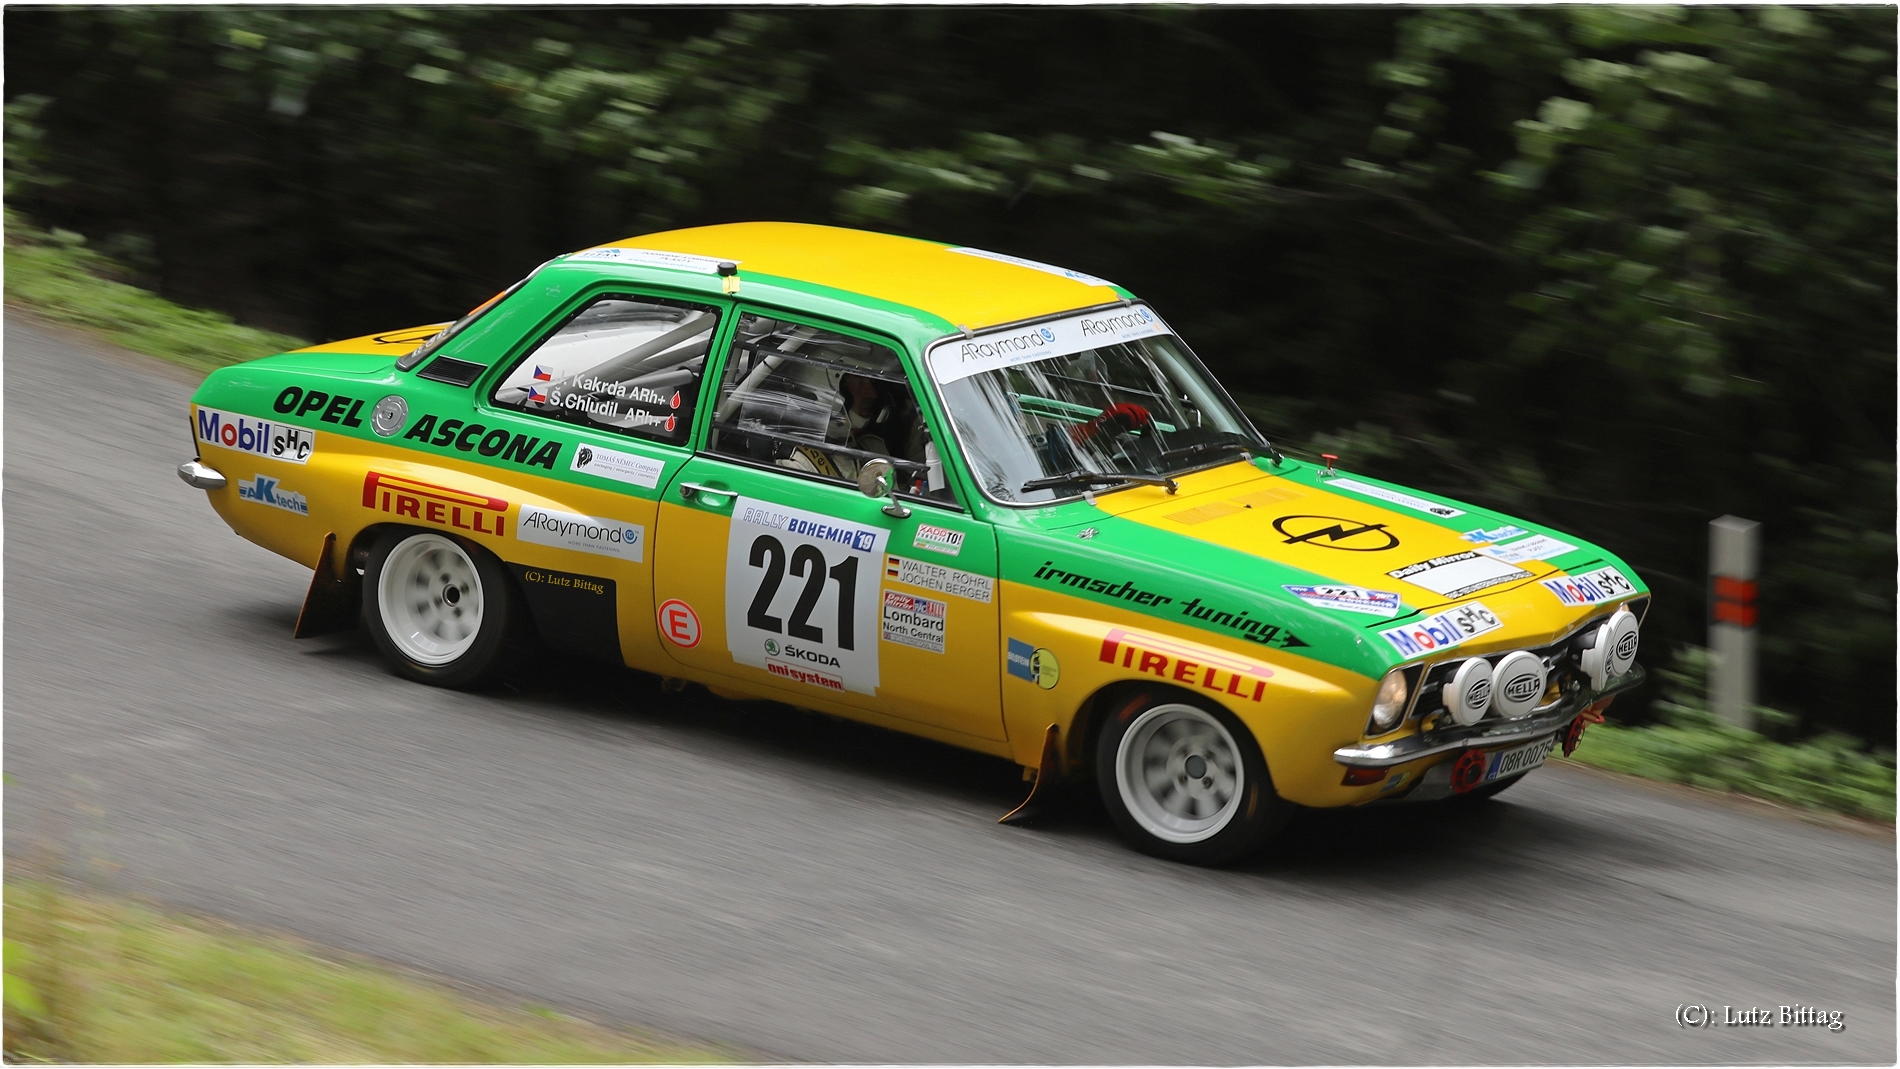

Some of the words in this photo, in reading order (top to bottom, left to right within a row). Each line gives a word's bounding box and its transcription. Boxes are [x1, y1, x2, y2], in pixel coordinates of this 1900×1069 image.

[1081, 310, 1147, 337] ARaymond
[961, 330, 1045, 363] ARaymond
[572, 374, 627, 397] Kakrda
[629, 386, 666, 405] ARh+
[273, 386, 366, 428] OPEL
[624, 407, 661, 427] ARh+
[199, 409, 271, 455] Mobil
[272, 429, 310, 459] SHC
[404, 413, 563, 470] ASCONA
[635, 462, 659, 474] Company
[362, 470, 509, 537] PIRELLI
[523, 511, 622, 543] ARaymond
[743, 507, 789, 529] RALLY
[788, 518, 853, 545] BOHEMIA
[902, 560, 946, 579] WALTER
[952, 571, 991, 590] RÖHRL
[1388, 560, 1432, 579] Daily
[1430, 551, 1476, 568] Mirror
[747, 534, 859, 652] 221
[887, 593, 912, 604] Daily
[900, 572, 943, 590] JOCHEN
[945, 582, 990, 602] BERGER
[1544, 576, 1606, 604] Mobil
[884, 606, 944, 631] Lombard
[885, 598, 914, 610] Mirror
[1033, 561, 1172, 608] irmscher
[1179, 598, 1282, 646] tuning
[669, 609, 691, 640] E
[883, 621, 908, 635] North
[910, 628, 944, 643] Central
[1385, 615, 1465, 656] Mobil
[784, 644, 841, 668] ŠKODA
[1098, 628, 1274, 702] PIRELLI
[1508, 677, 1540, 695] HELLA
